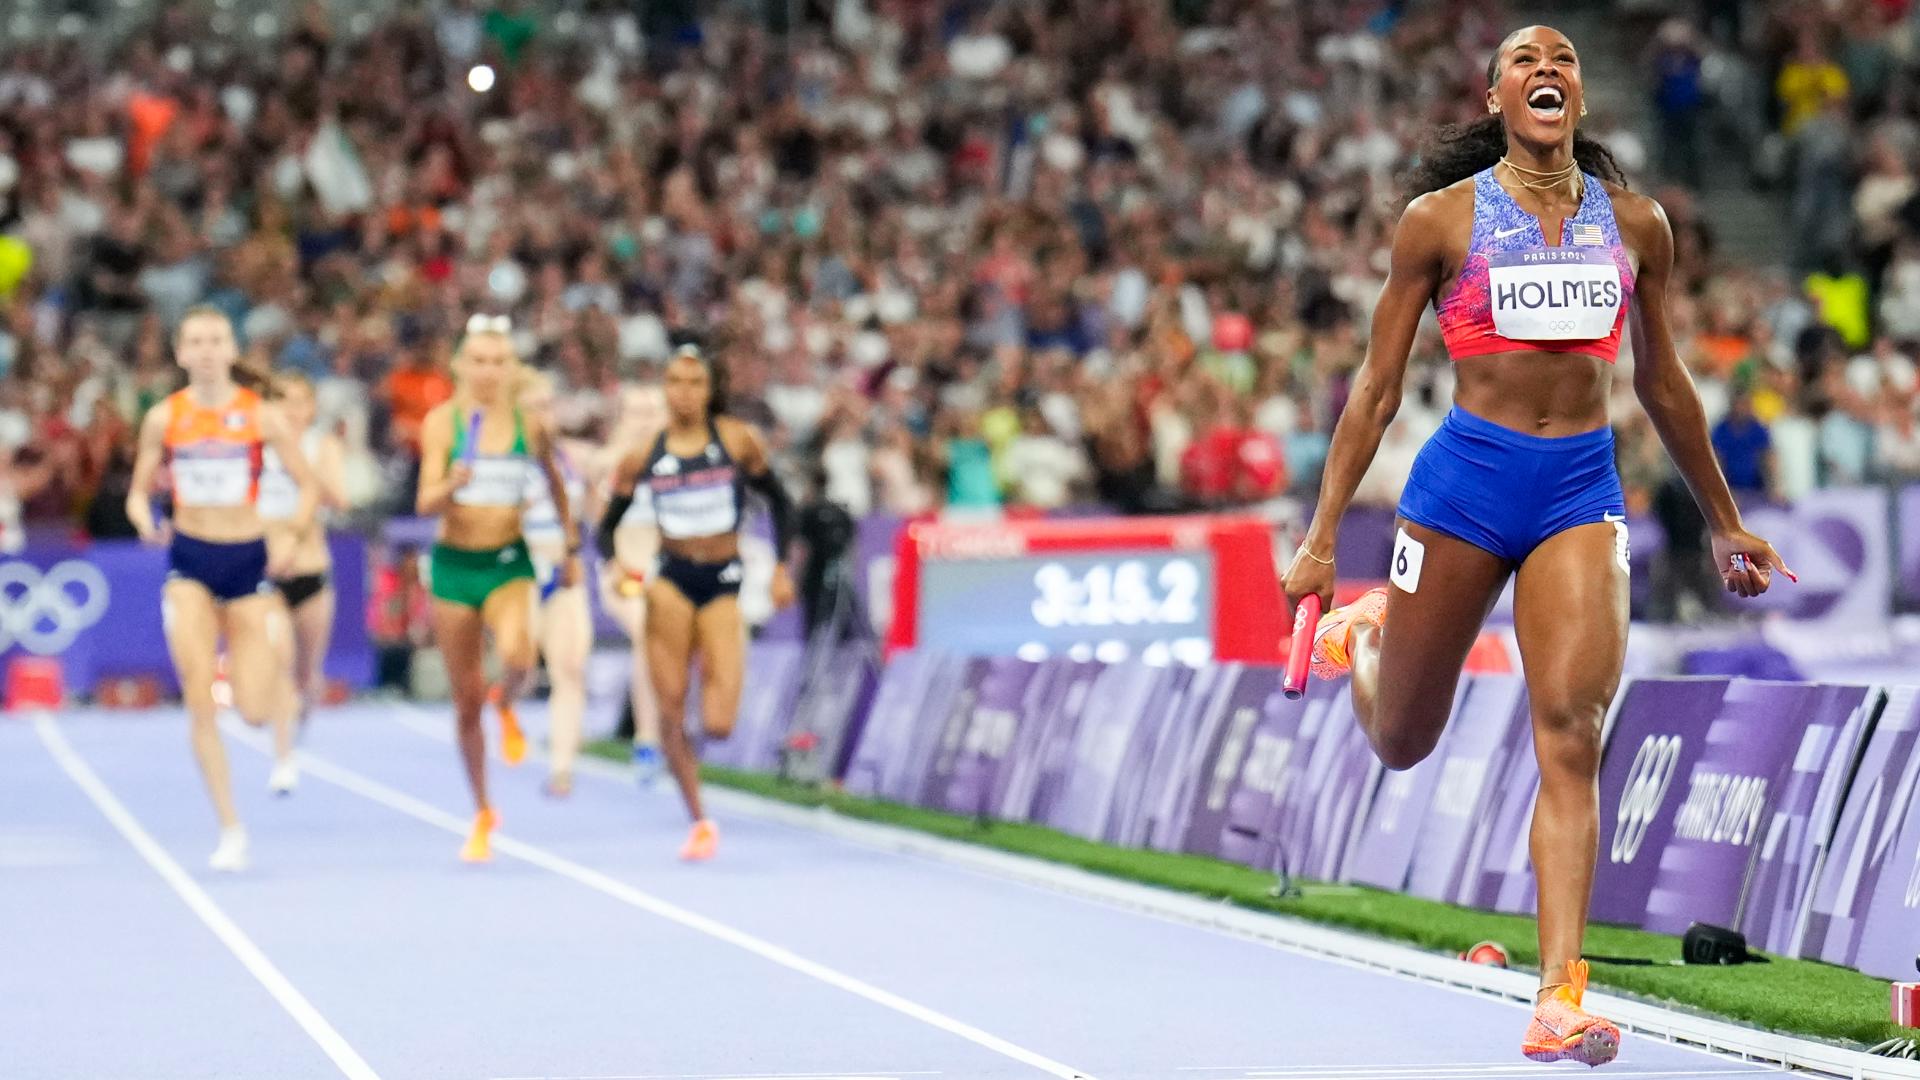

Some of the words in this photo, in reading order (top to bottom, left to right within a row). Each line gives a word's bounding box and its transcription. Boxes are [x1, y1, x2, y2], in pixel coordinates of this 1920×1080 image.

[1523, 251, 1557, 262] PARIS
[1560, 251, 1586, 261] 2024
[1496, 280, 1618, 311] HOLMES
[1396, 545, 1408, 576] 6
